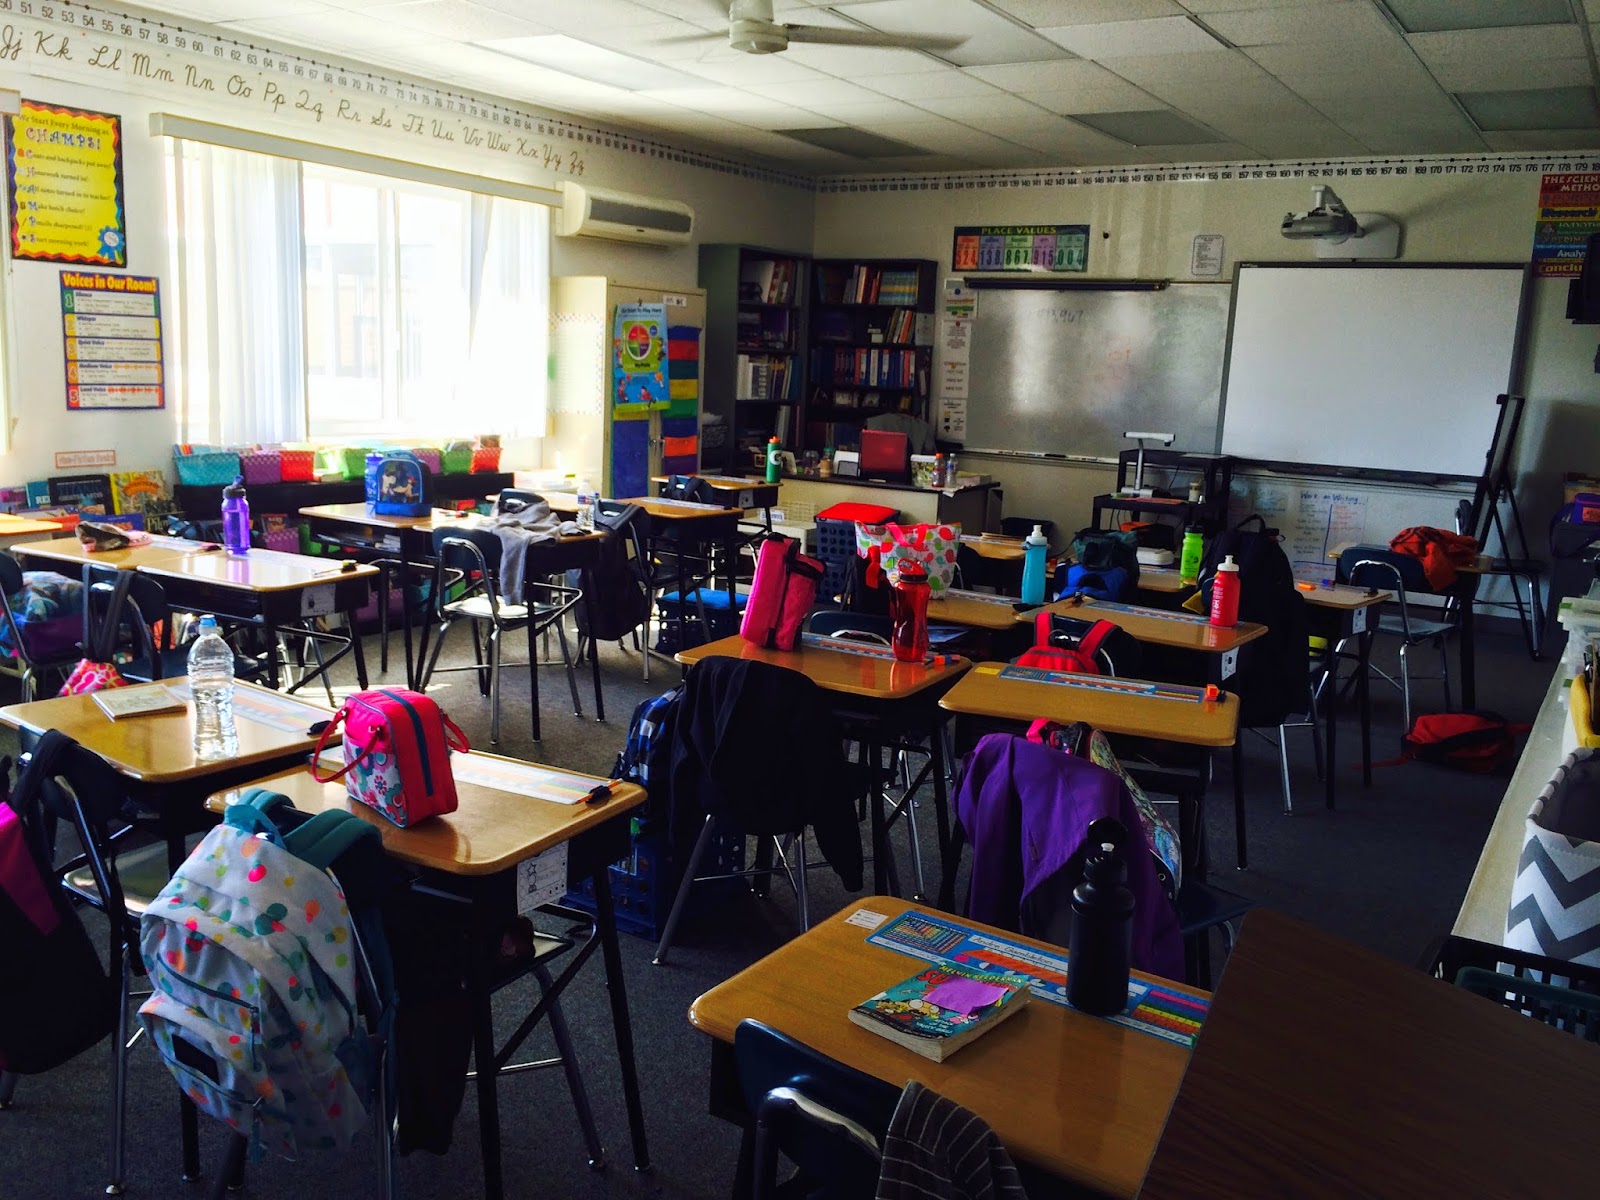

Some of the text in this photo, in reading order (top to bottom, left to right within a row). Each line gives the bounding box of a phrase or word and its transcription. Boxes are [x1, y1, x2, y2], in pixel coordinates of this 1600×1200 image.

[20, 1, 32, 15] 51
[41, 5, 54, 19] 52
[61, 10, 75, 24] 53
[82, 15, 95, 28] 54
[101, 19, 114, 32] 55
[120, 24, 133, 37] 56
[139, 28, 151, 41] 57
[157, 32, 169, 45] 58
[175, 36, 186, 49] 59
[192, 40, 204, 53] 60
[213, 45, 224, 57] 61
[230, 49, 241, 61] 62
[246, 53, 258, 65] 63
[263, 57, 273, 69] 64
[278, 61, 289, 72] 65
[294, 64, 304, 76] 66
[308, 68, 319, 79] 67
[323, 71, 333, 83] 68
[337, 75, 347, 86] 69
[352, 78, 362, 89] 70
[366, 81, 374, 92] 71
[71, 122, 100, 135] Morning
[26, 127, 101, 150] CHAMPS!
[1067, 177, 1078, 185] 144
[1094, 176, 1105, 184] 146
[1106, 176, 1117, 184] 147
[1119, 175, 1129, 183] 148
[1131, 175, 1142, 183] 149
[1143, 174, 1154, 182] 150
[1156, 174, 1166, 182] 151
[1168, 173, 1180, 181] 152
[1181, 173, 1193, 181] 153
[1195, 172, 1206, 181] 154
[1207, 172, 1219, 180] 155
[1221, 172, 1232, 180] 156
[1238, 171, 1250, 179] 157
[1252, 170, 1263, 179] 158
[1266, 170, 1277, 178] 159
[1279, 170, 1291, 178] 160
[1293, 169, 1304, 177] 161
[1307, 169, 1319, 177] 162
[1322, 168, 1334, 177] 163
[1336, 168, 1348, 176] 164
[1350, 167, 1363, 176] 165
[1365, 167, 1378, 175] 166
[1380, 166, 1393, 175] 167
[1395, 166, 1408, 175] 168
[1414, 166, 1427, 174] 169
[1430, 165, 1443, 174] 170
[1445, 165, 1457, 174] 171
[1461, 164, 1474, 173] 172
[1476, 164, 1490, 173] 173
[1493, 164, 1506, 173] 174
[1509, 164, 1522, 172] 175
[1525, 163, 1538, 172] 176
[1541, 163, 1555, 172] 177
[1558, 163, 1572, 172] 178
[1574, 163, 1589, 172] 179
[1544, 176, 1599, 184] THE SCIEN
[1561, 184, 1600, 192] METHO
[1016, 226, 1056, 234] VALUES
[1557, 250, 1586, 258] Analy
[63, 273, 157, 292] Voices in Our Room!
[70, 390, 77, 402] 5
